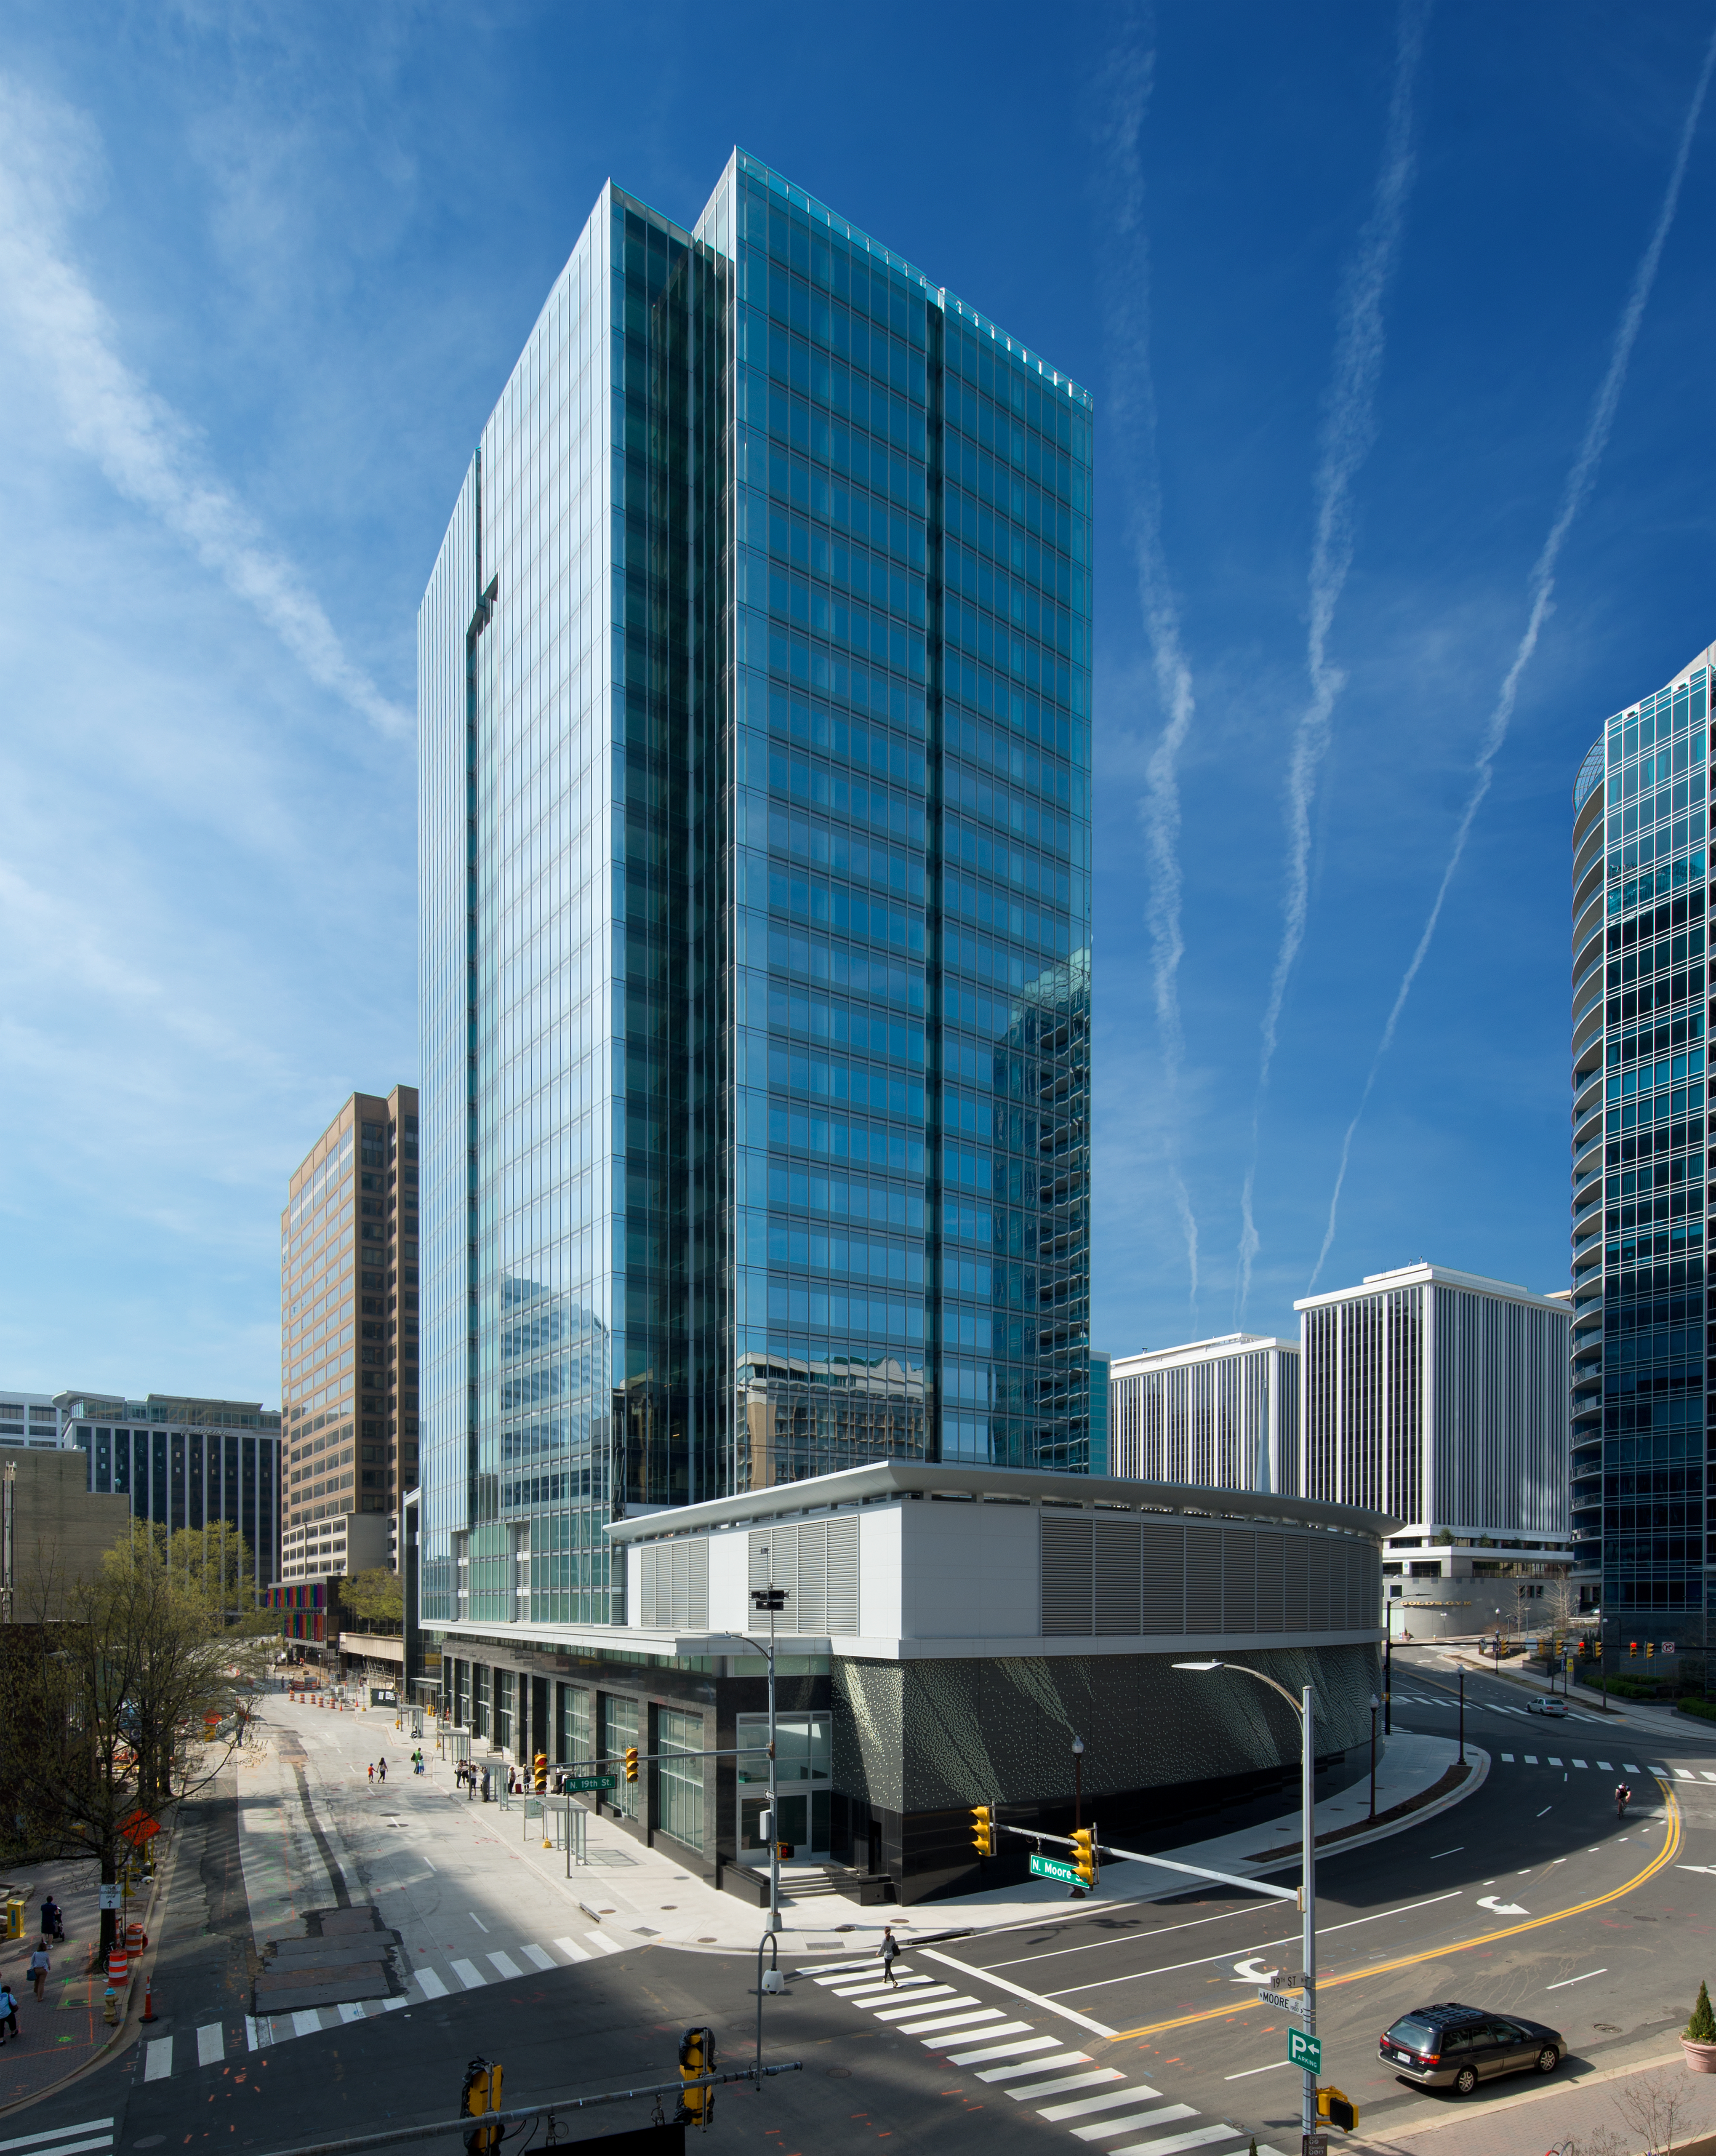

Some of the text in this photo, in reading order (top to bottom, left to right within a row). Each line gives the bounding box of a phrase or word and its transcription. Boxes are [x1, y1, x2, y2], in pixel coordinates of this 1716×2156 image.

[581, 1780, 597, 1788] 19th
[1033, 1859, 1041, 1871] N.
[1045, 1862, 1071, 1879] Moore
[1273, 1977, 1285, 1988] 19TH
[1288, 1976, 1296, 1986] ST
[1263, 1992, 1289, 2009] MOORE
